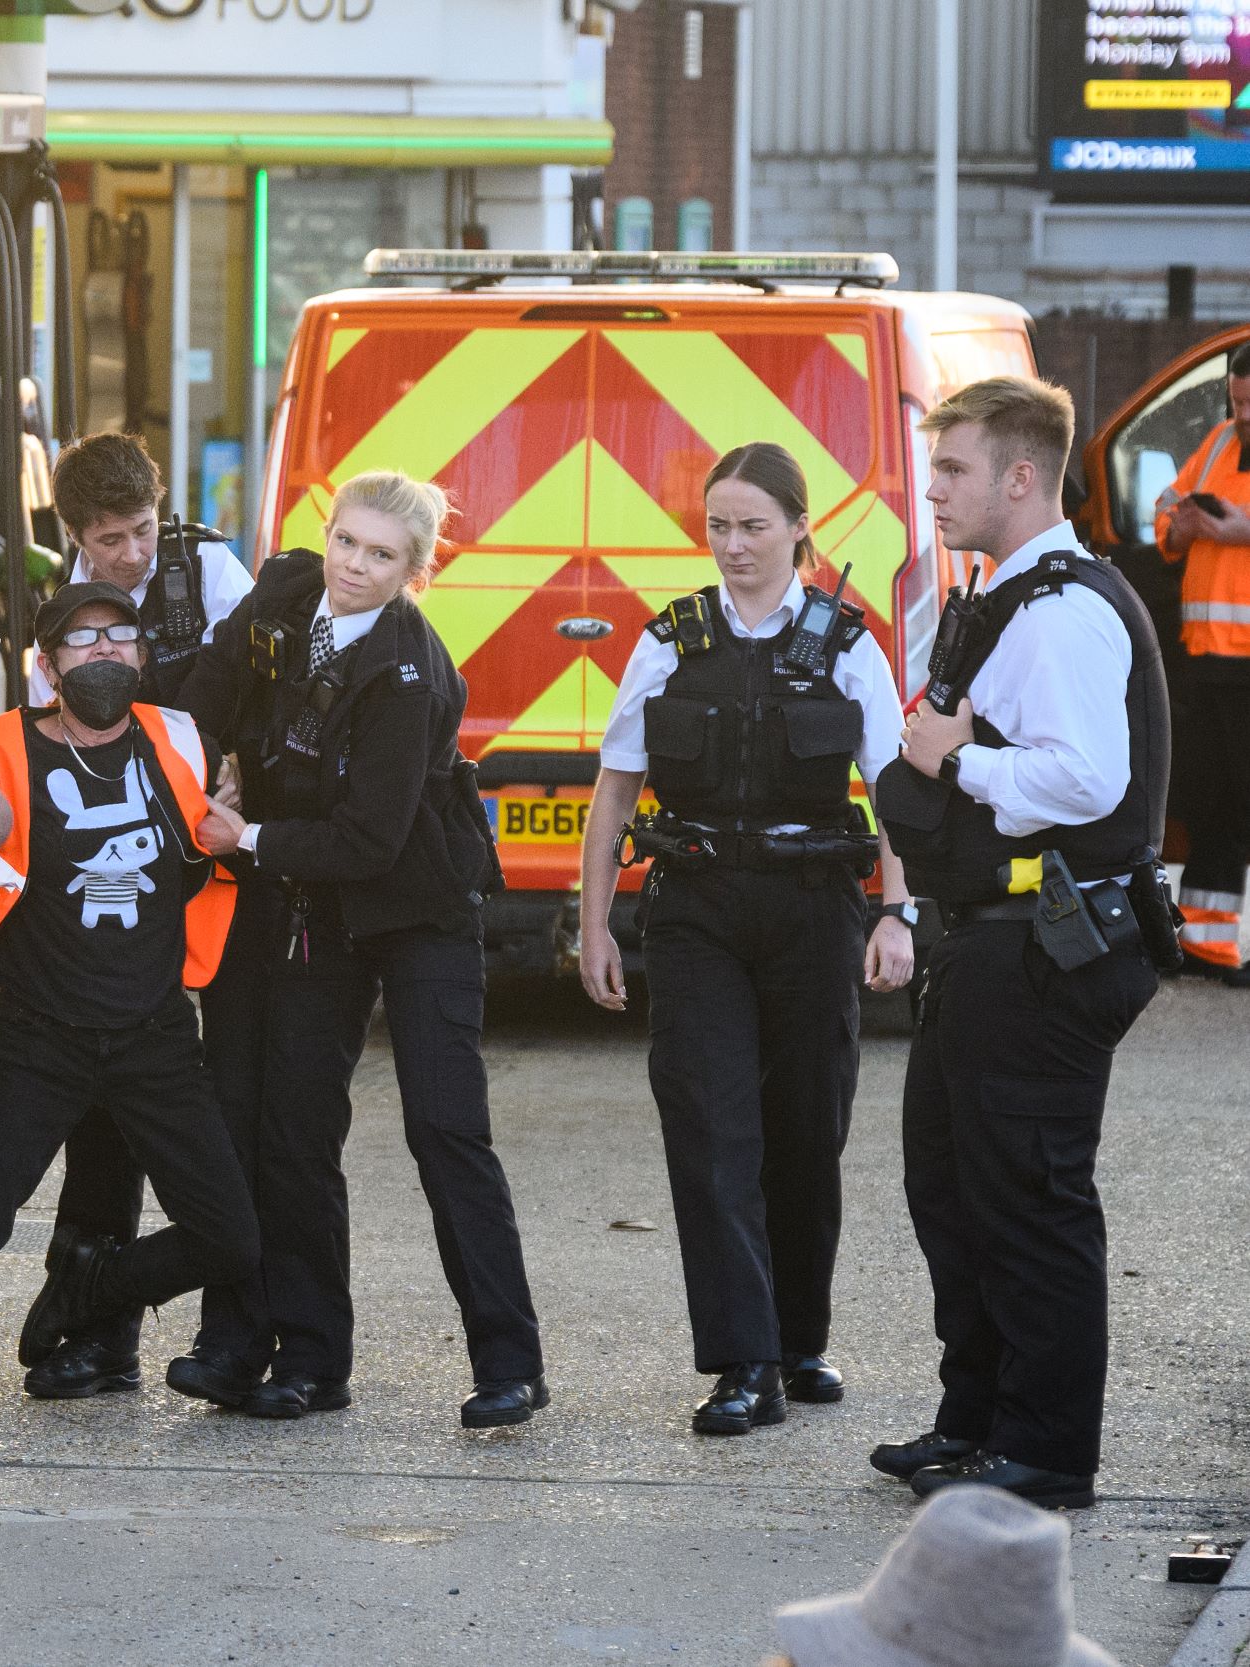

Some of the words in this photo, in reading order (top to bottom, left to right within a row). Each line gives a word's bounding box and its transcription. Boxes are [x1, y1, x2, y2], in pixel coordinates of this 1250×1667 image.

[1086, 38, 1178, 69] Monday
[1063, 140, 1197, 169] JCDecaux
[157, 653, 180, 664] POLICE
[399, 664, 417, 673] WA
[401, 672, 420, 682] 1914
[286, 739, 307, 753] POLICE
